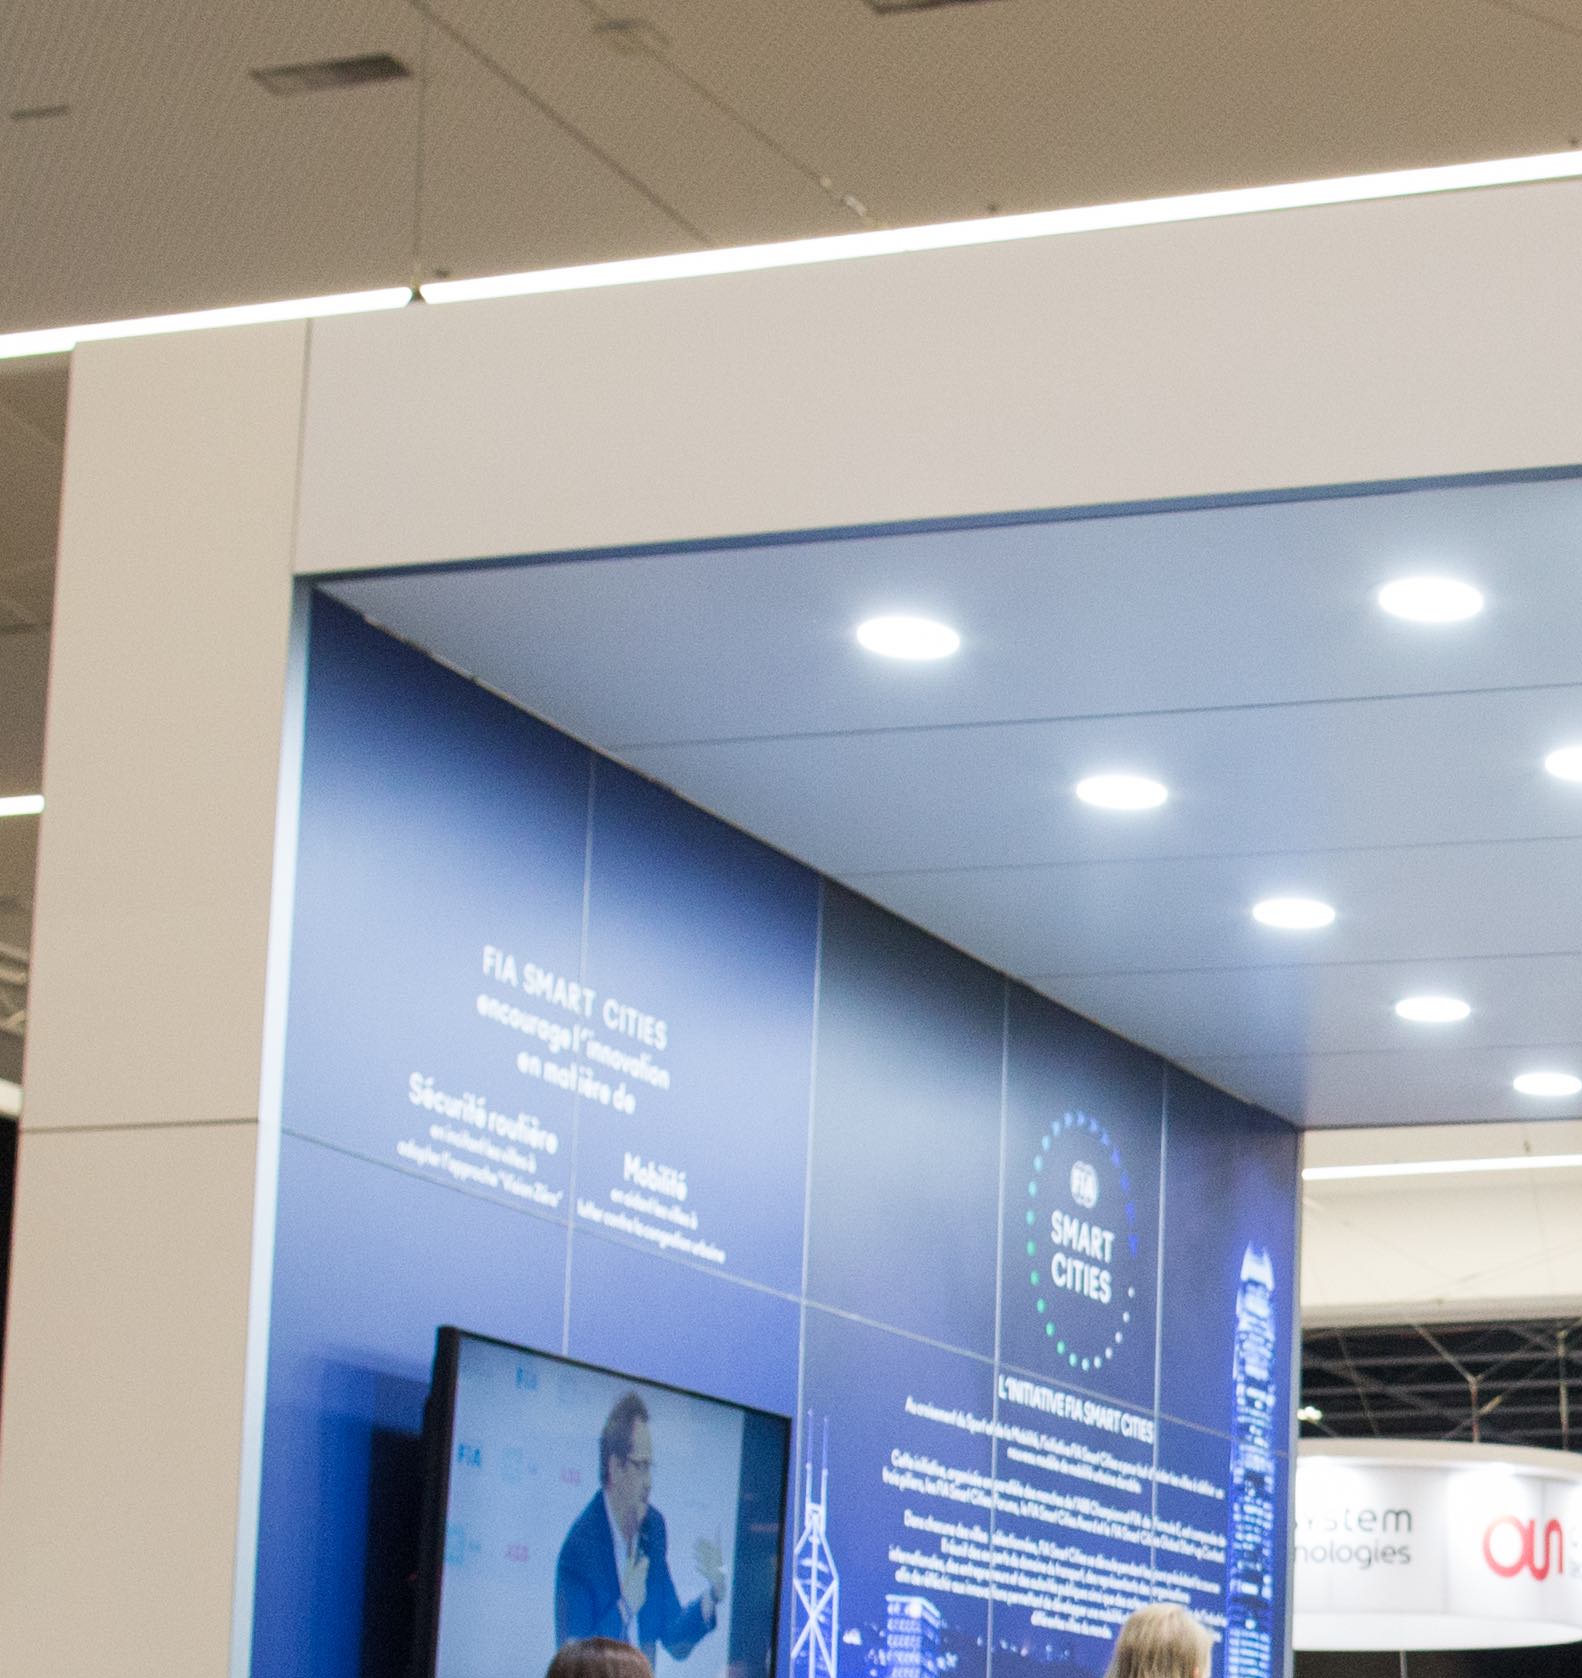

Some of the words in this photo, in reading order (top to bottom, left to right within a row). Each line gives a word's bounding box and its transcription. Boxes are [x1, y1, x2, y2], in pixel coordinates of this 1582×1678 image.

[476, 994, 571, 1053] encourage
[482, 944, 518, 988] FIA
[523, 962, 596, 1018] SMART
[603, 997, 668, 1051] CITIES
[409, 1071, 487, 1130] Sécurité
[516, 1050, 542, 1077] en
[613, 1082, 637, 1115] de
[623, 1151, 688, 1202] Mobilité
[1050, 1209, 1115, 1264] SMART
[1050, 1252, 1113, 1304] CITIES
[1084, 1401, 1121, 1434] SMART
[1120, 1412, 1155, 1445] CITIES
[1294, 1508, 1413, 1536] ystem
